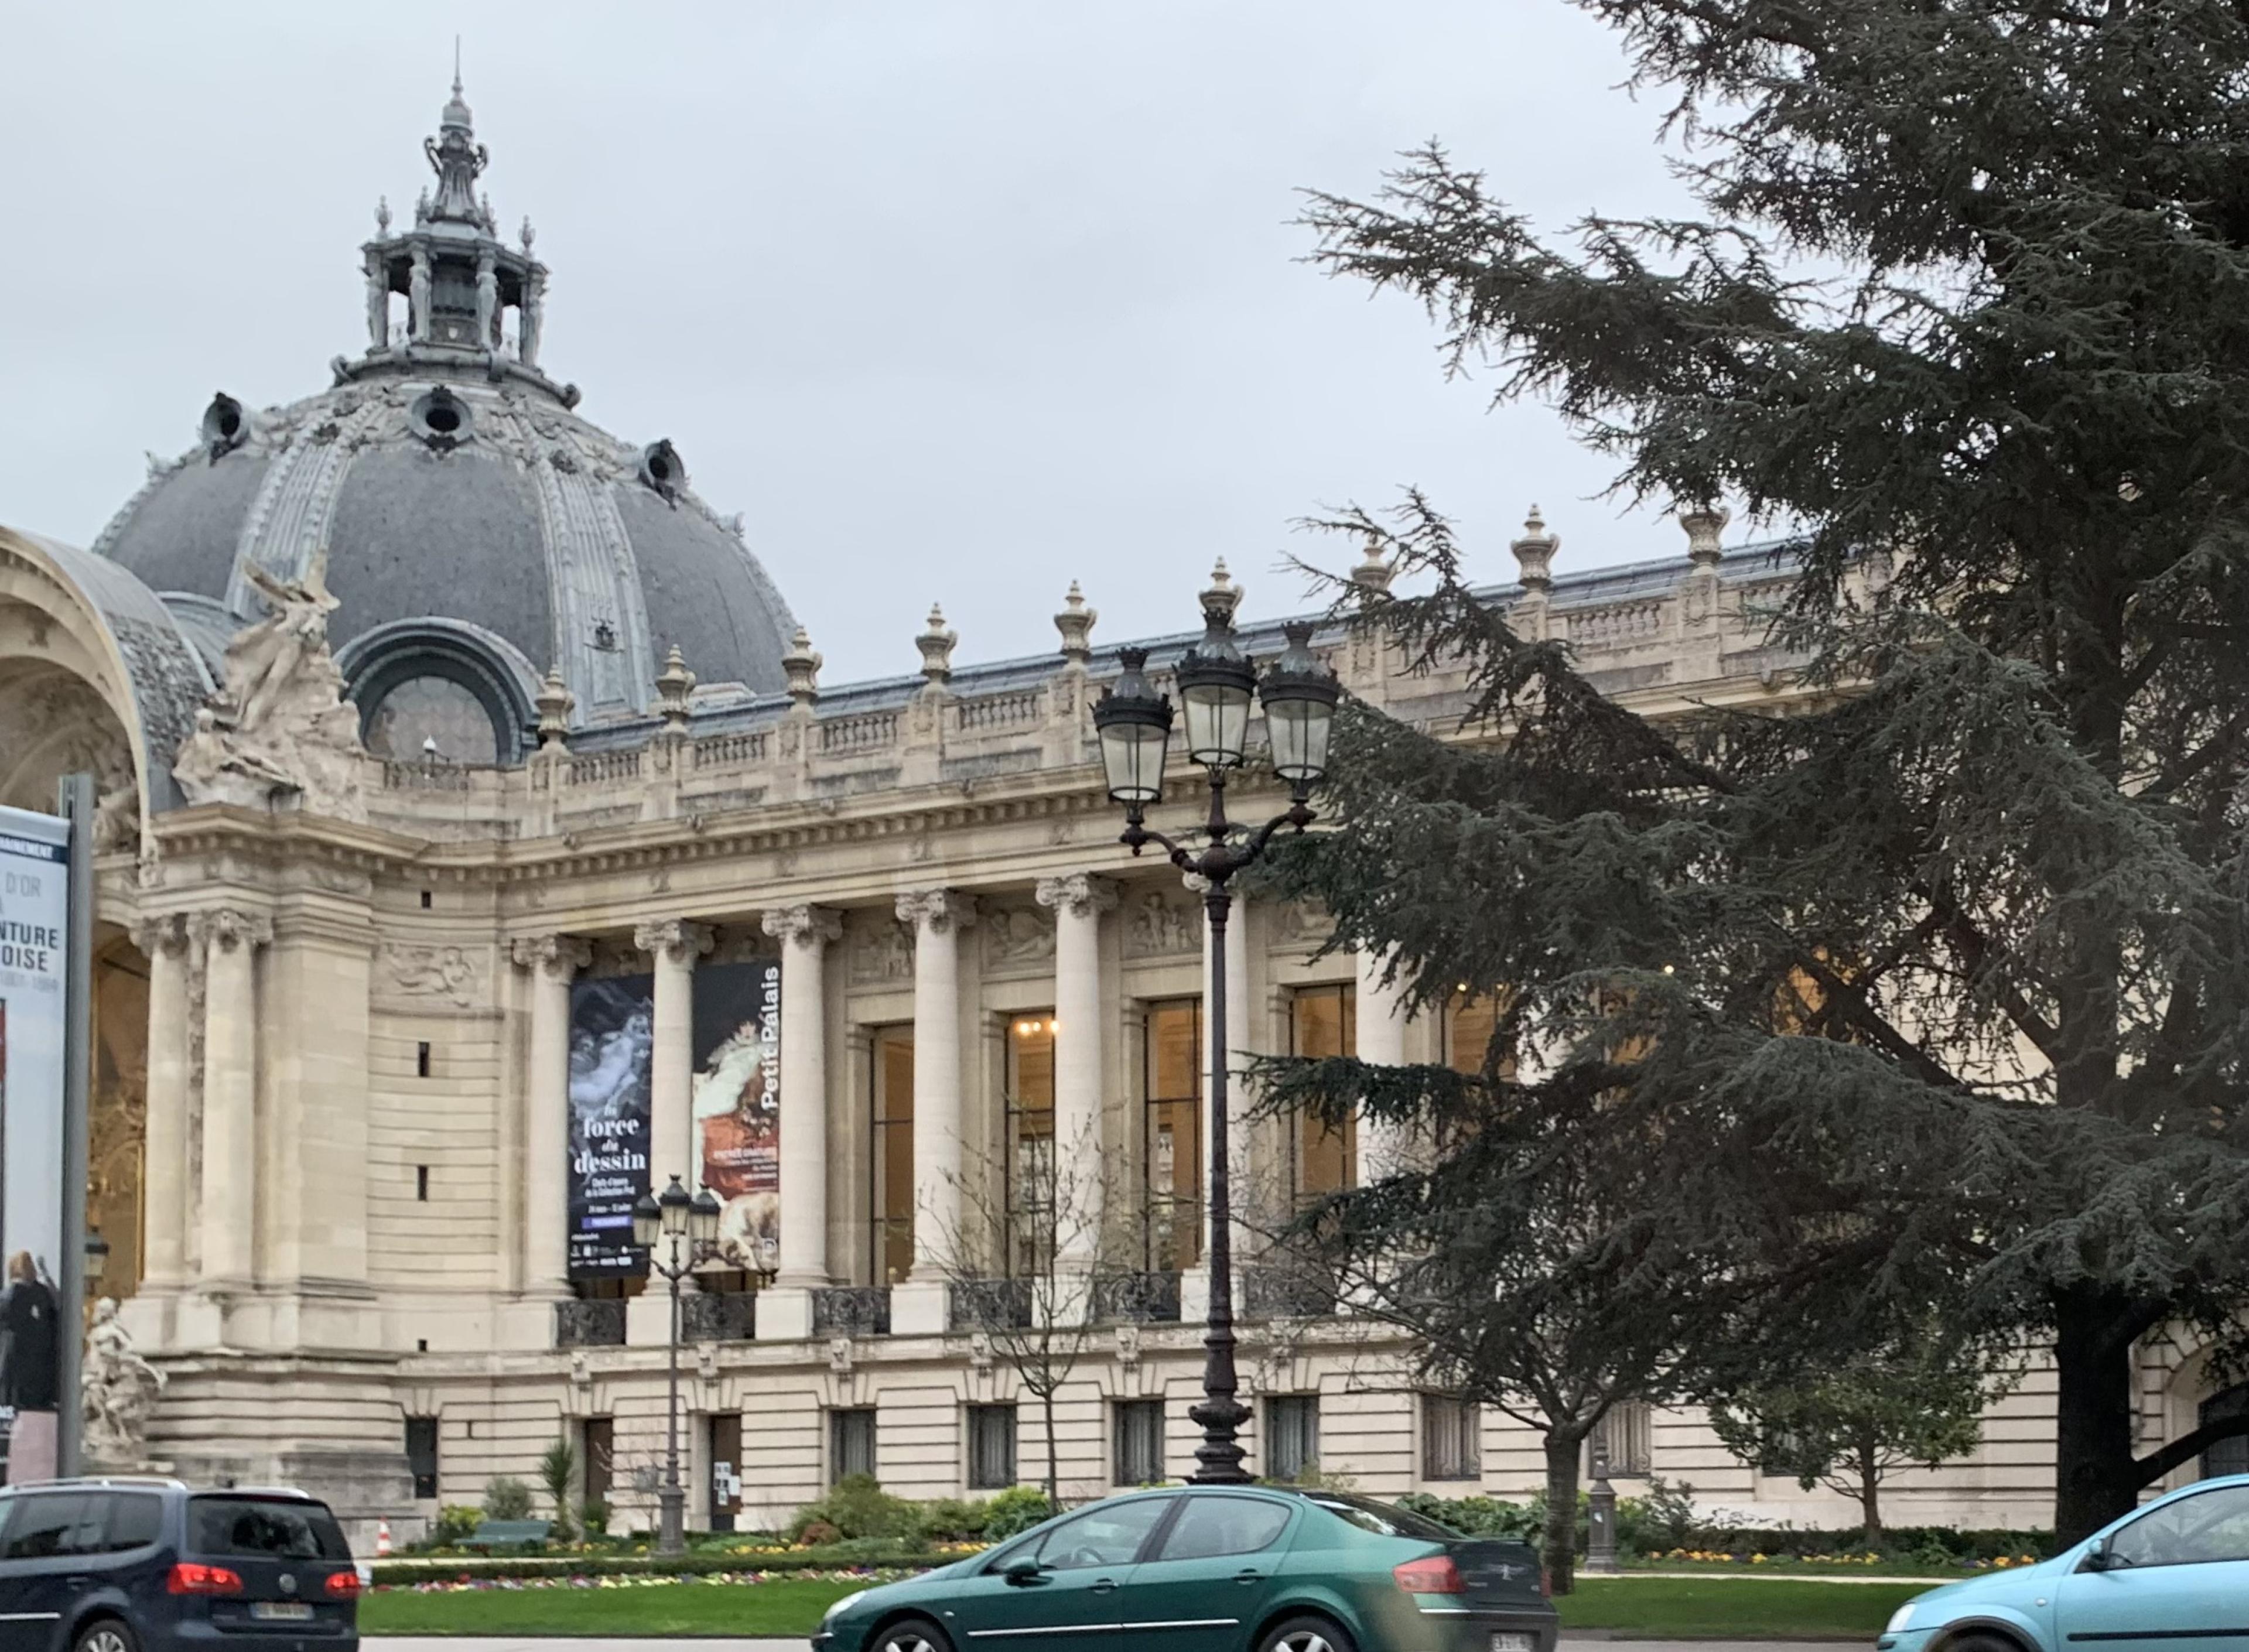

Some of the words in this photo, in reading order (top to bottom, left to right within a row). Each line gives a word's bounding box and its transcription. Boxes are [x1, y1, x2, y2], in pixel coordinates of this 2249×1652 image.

[2, 945, 48, 972] OISE
[761, 966, 779, 1042] Palais
[761, 1046, 778, 1110] Petit
[583, 1116, 640, 1138] force
[575, 1147, 646, 1174] dessin
